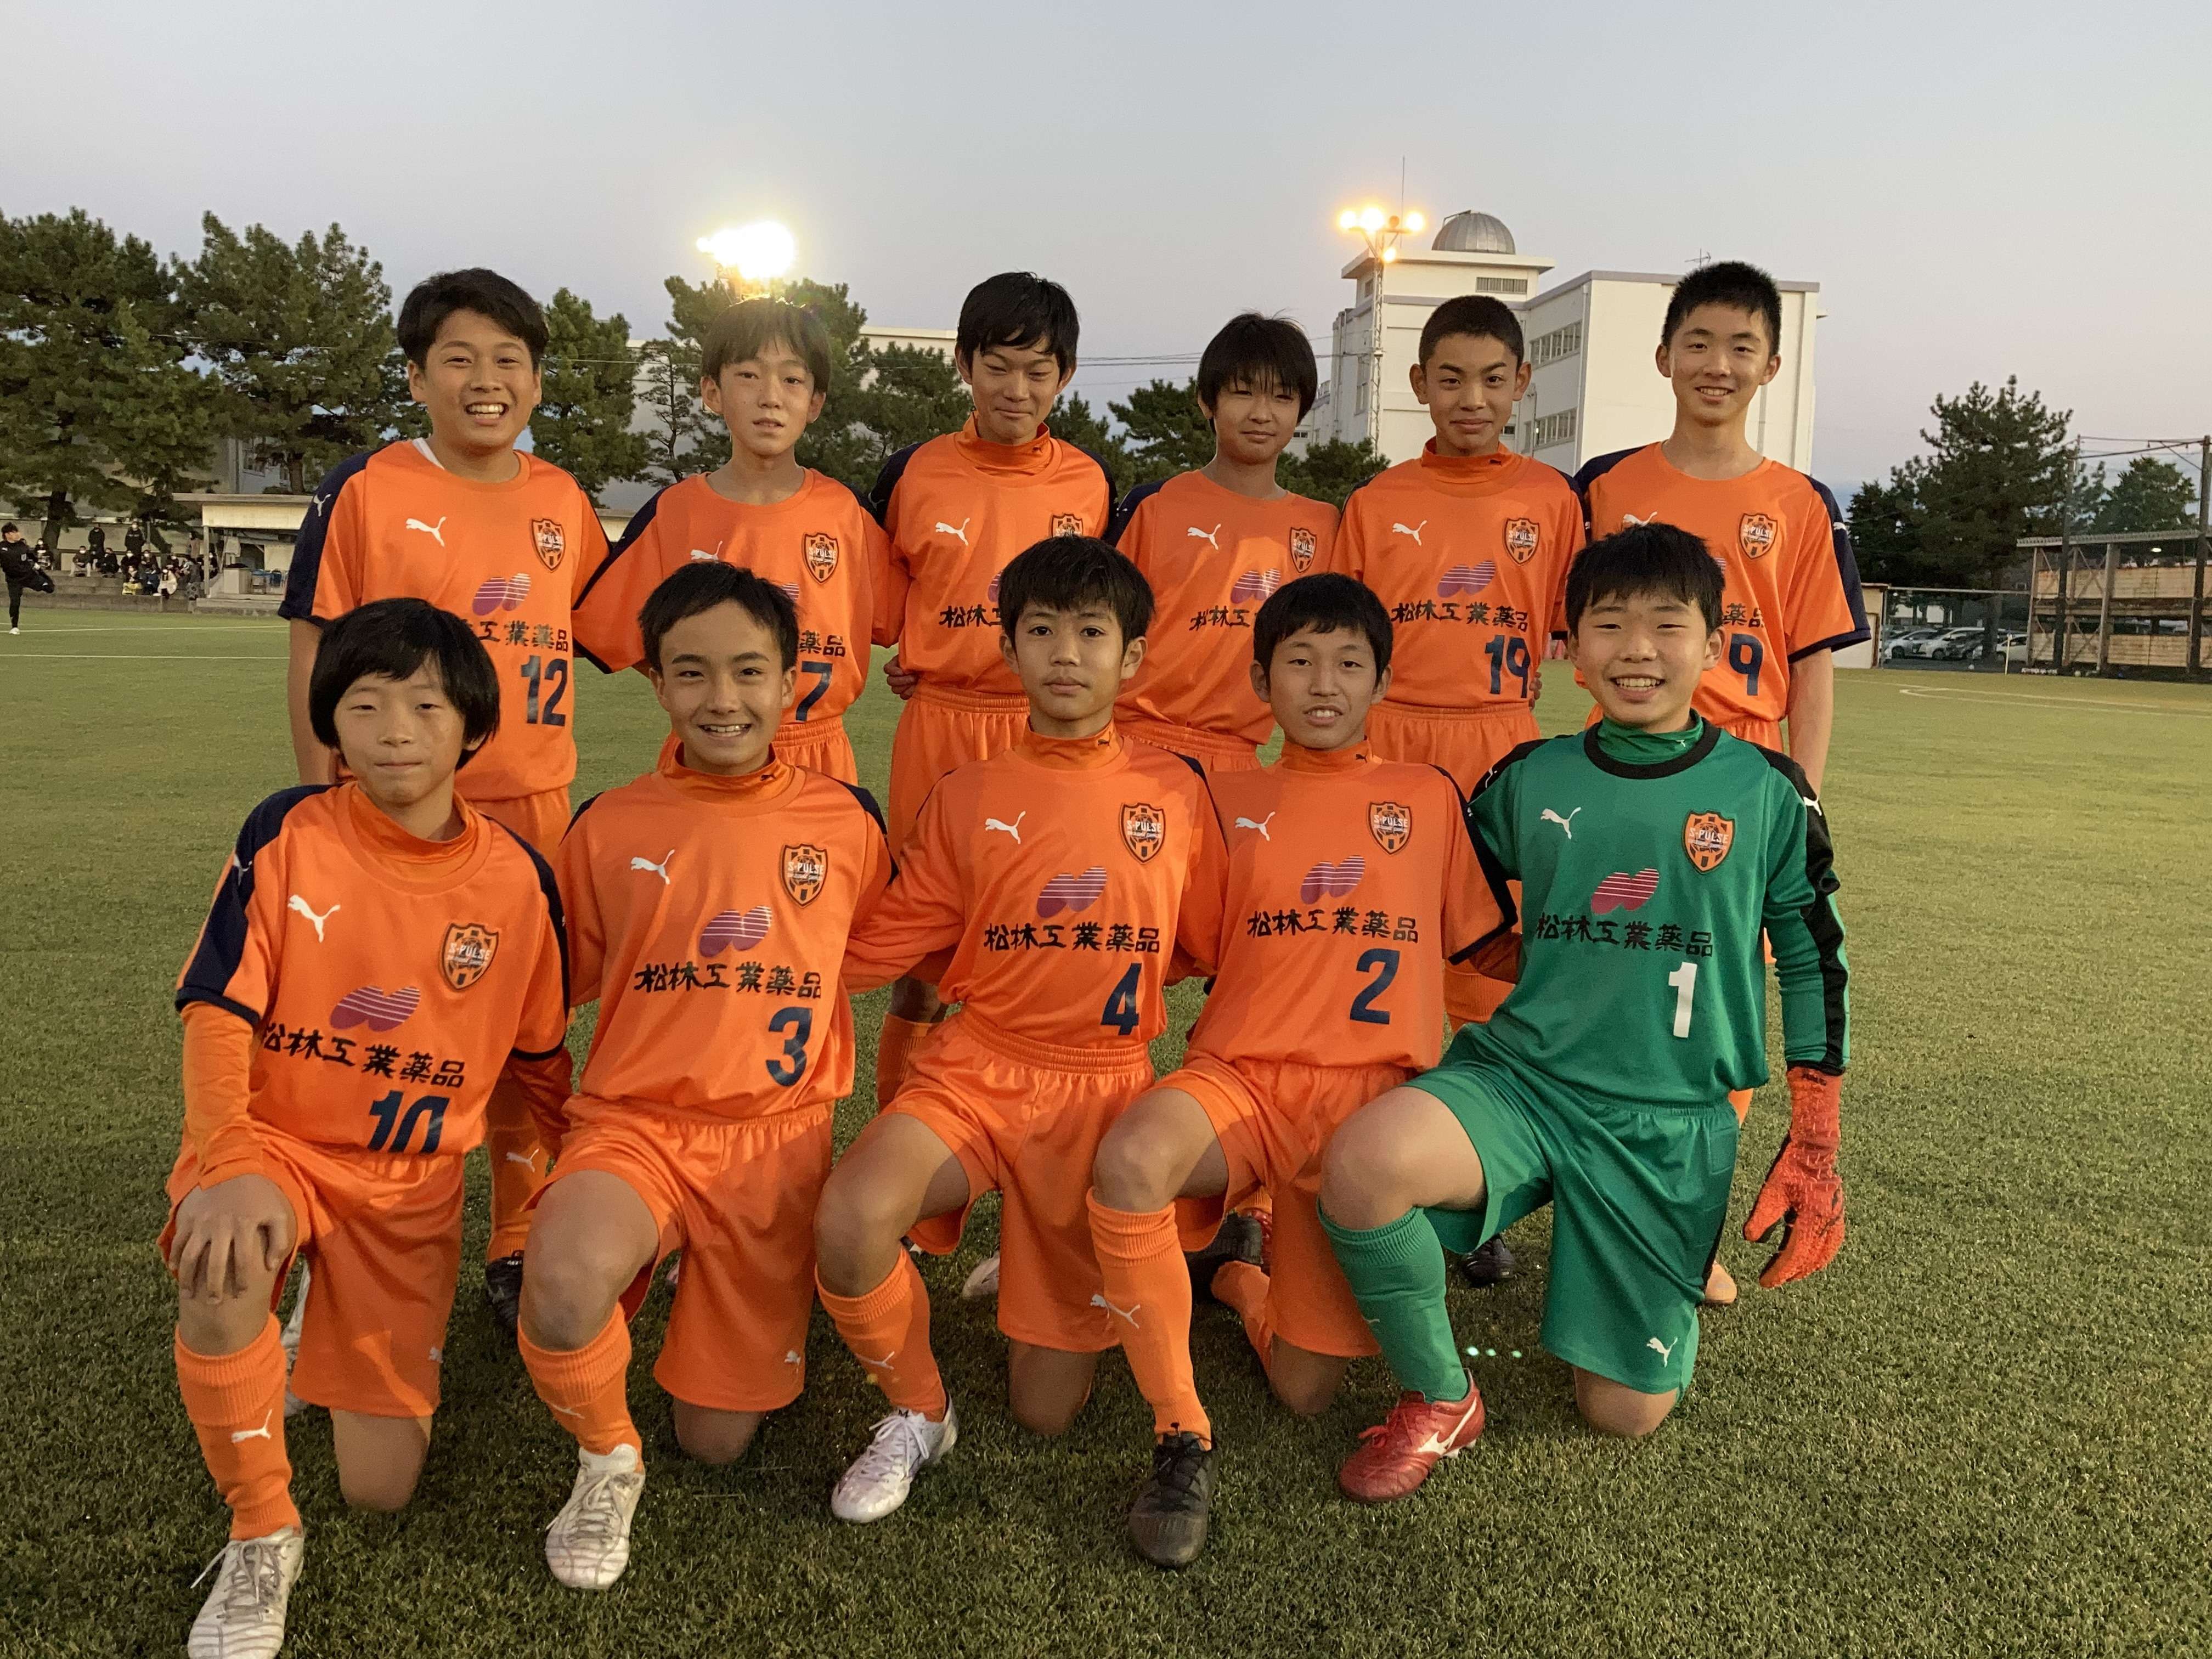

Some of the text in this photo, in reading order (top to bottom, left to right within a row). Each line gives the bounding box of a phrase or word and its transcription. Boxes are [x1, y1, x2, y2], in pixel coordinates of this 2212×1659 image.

[520, 654, 568, 727] 12
[795, 661, 833, 722] 7
[1485, 634, 1531, 699] 19
[1729, 633, 1763, 697] 9
[983, 922, 1160, 954] 松林工業薬品
[1246, 907, 1419, 944] 松林工業薬品
[1536, 912, 1713, 957] 松林工業薬品
[634, 961, 821, 999] 松林工業薬品
[1100, 962, 1143, 1036] 4
[1350, 948, 1401, 1025] 2
[1668, 961, 1698, 1039] 1
[765, 1006, 813, 1087] 3
[366, 1088, 450, 1153] 10
